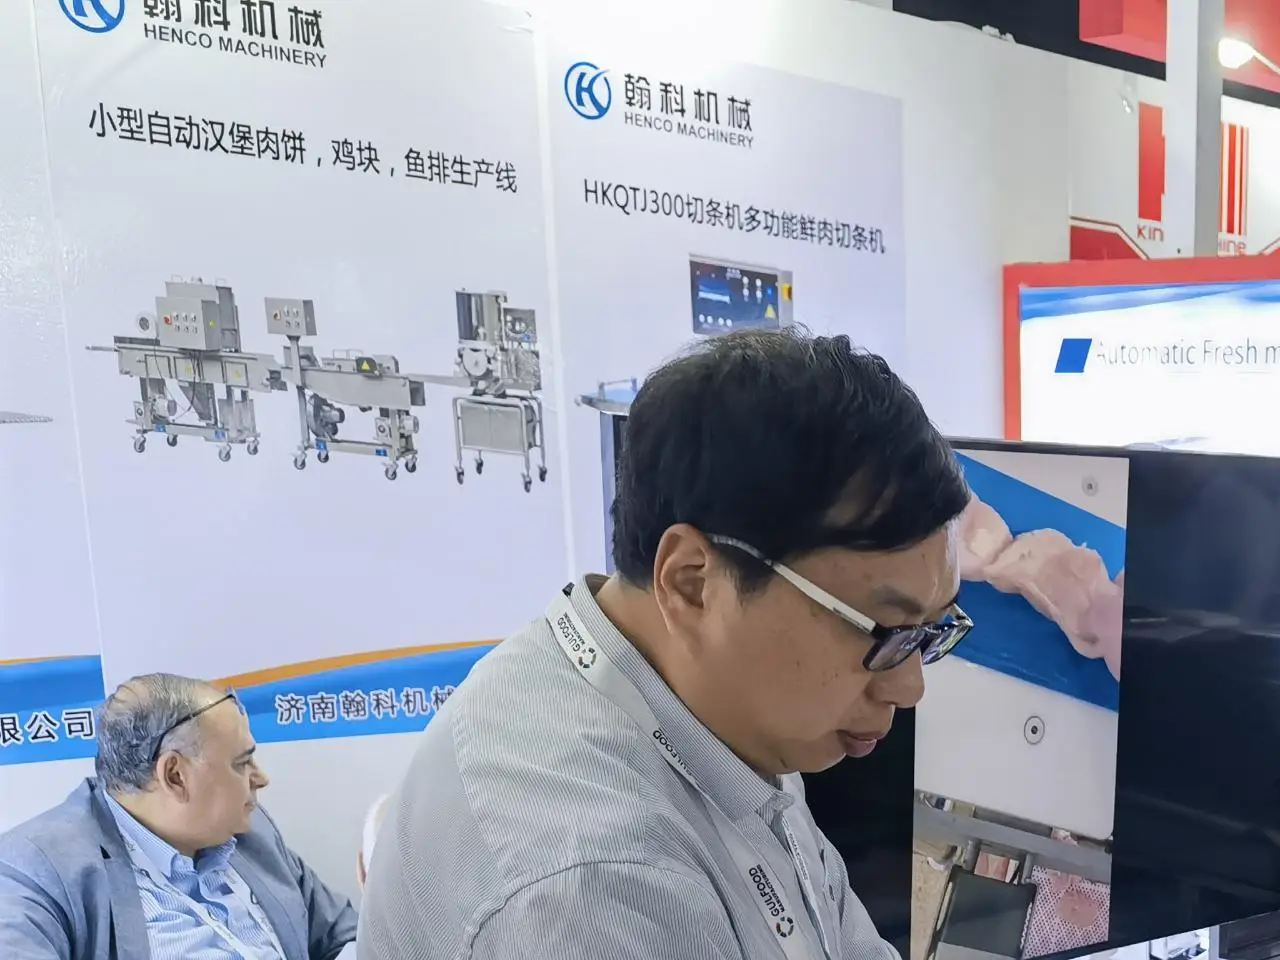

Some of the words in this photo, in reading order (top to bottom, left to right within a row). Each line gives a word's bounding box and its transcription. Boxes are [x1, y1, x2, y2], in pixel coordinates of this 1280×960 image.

[143, 23, 213, 50] HENCO
[218, 35, 327, 68] MACHINERY
[624, 72, 753, 133] 翰科机械
[624, 111, 673, 134] HENCO
[676, 119, 754, 149] MACHINERY
[1097, 341, 1196, 366] Automatic
[1202, 339, 1257, 366] Fresh
[557, 617, 581, 652] GULFOOD
[749, 867, 780, 917] GULFOOD
